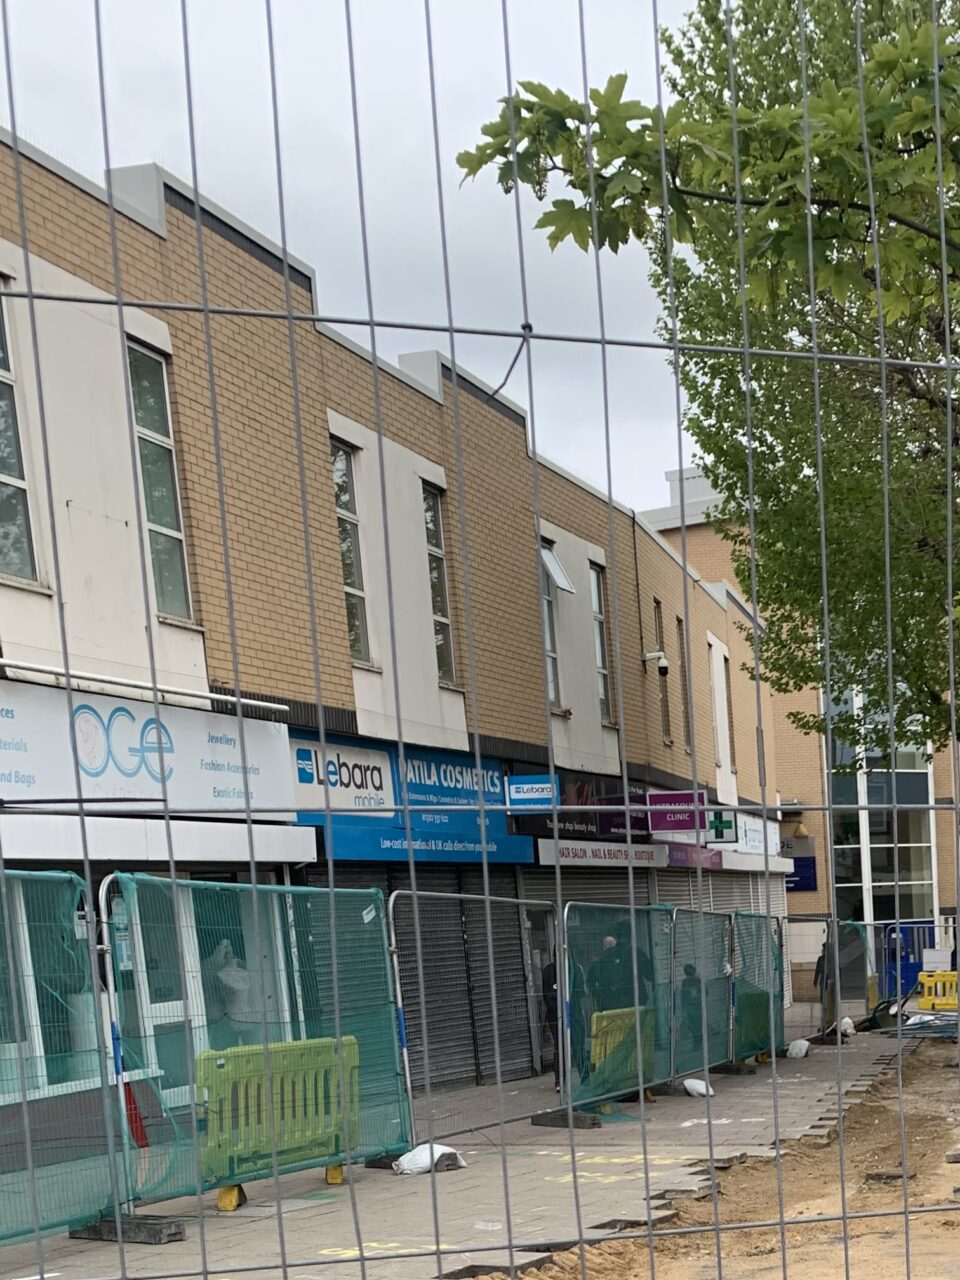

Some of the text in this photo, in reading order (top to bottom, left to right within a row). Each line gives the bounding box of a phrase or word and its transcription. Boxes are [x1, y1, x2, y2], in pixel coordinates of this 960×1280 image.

[207, 732, 236, 748] Jewellery
[200, 759, 260, 775] Fashion Acceories
[314, 750, 383, 791] Lebara
[14, 771, 36, 788] Bags
[440, 763, 501, 793] COSMETICS
[213, 787, 253, 799] Exotic Fabs
[522, 786, 552, 794] Lebara
[667, 813, 690, 821] CLINIC
[485, 842, 497, 852] obile
[571, 848, 587, 859] SALON
[592, 848, 602, 859] NAIL
[607, 849, 623, 860] BEAUTY
[634, 851, 655, 863] BOUTIQUE
